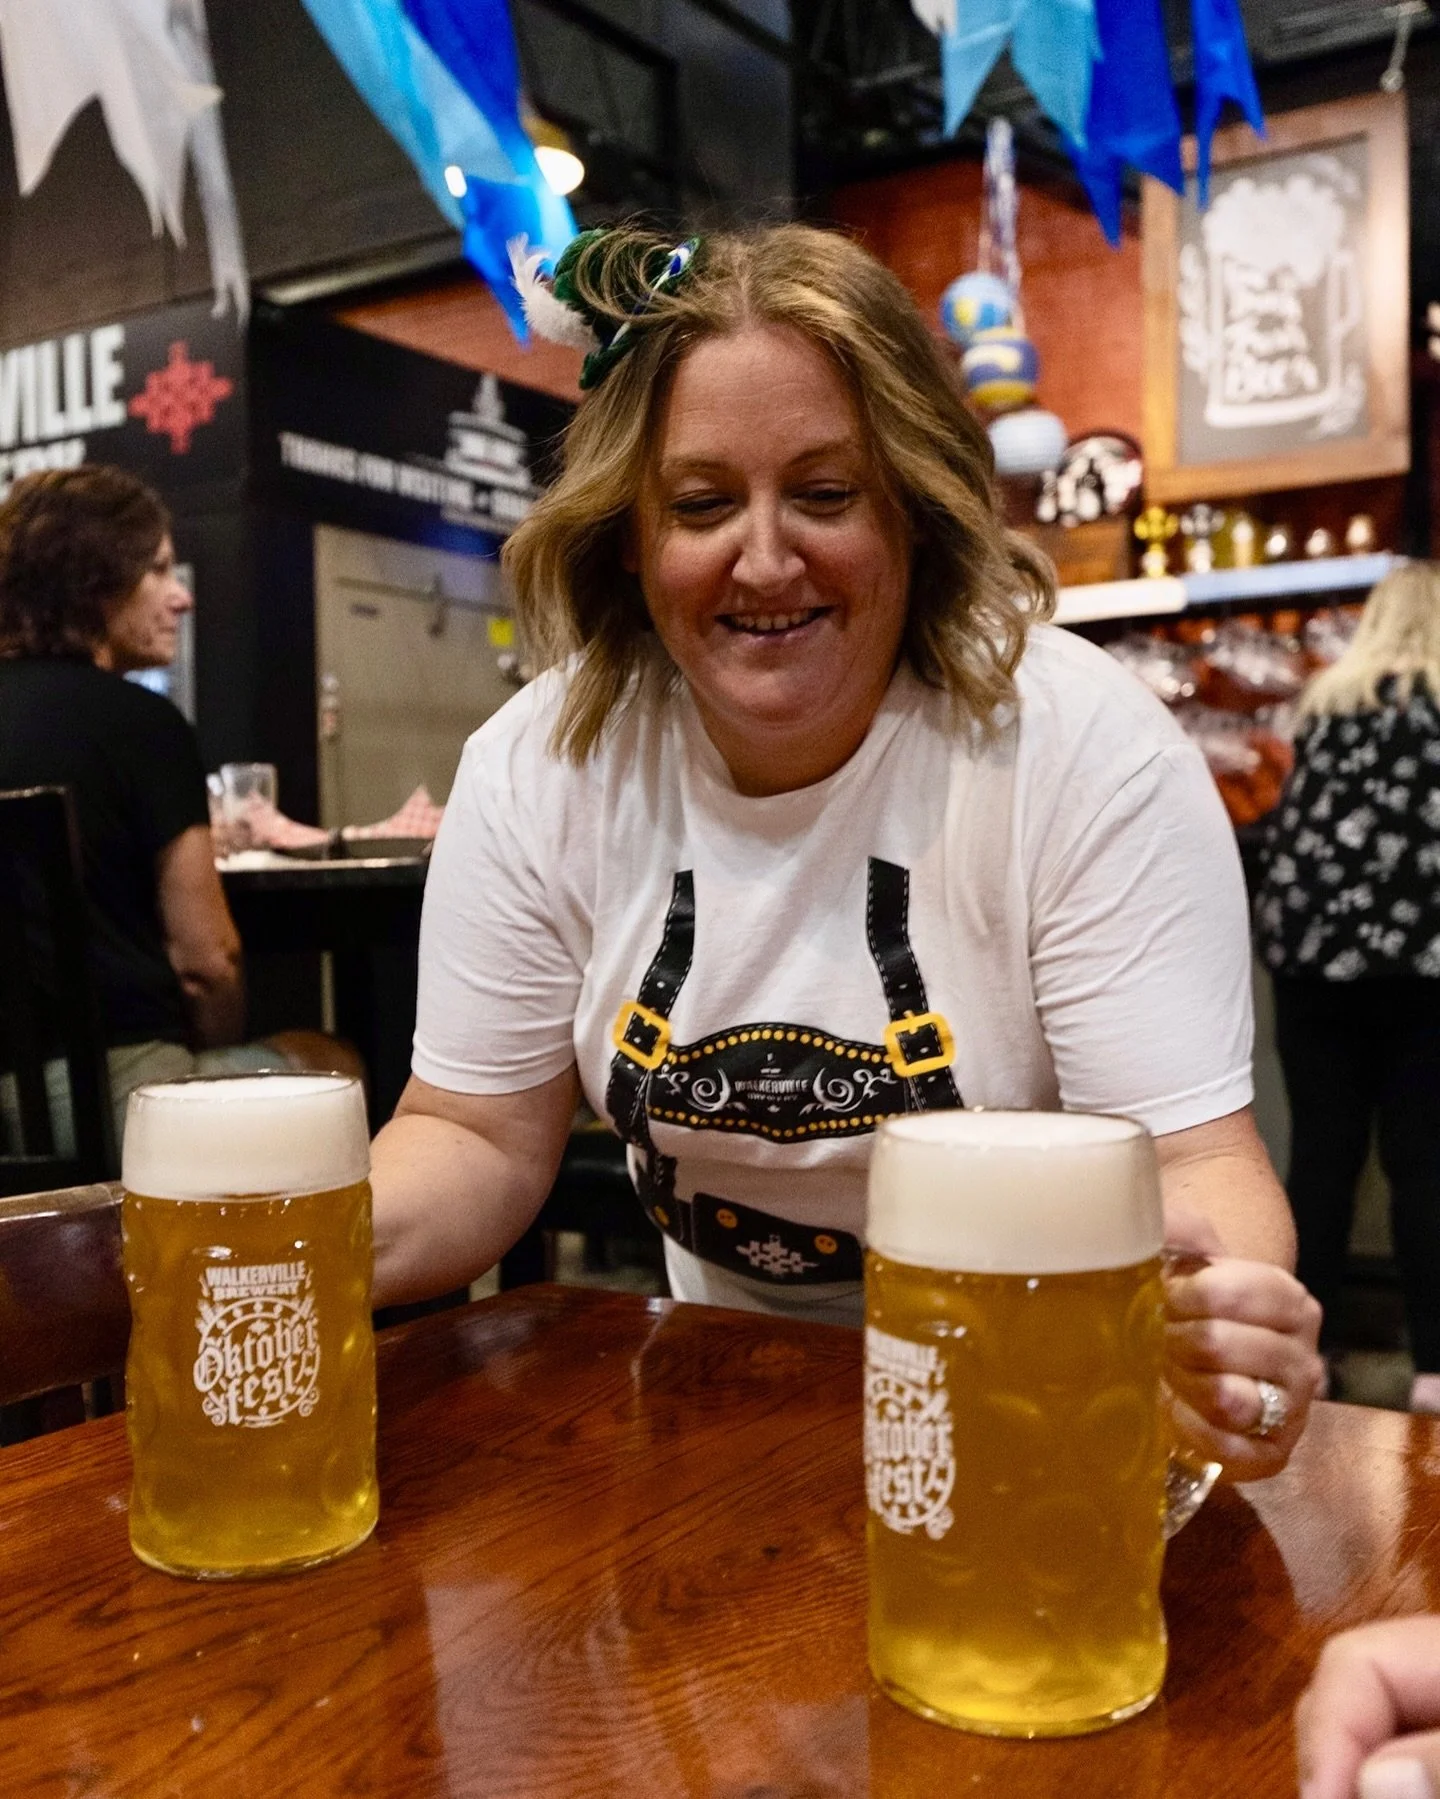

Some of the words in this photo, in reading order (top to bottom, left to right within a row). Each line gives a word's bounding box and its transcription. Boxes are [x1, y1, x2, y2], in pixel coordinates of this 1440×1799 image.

[734, 1079, 809, 1094] WALKERVILLE
[205, 1259, 307, 1289] WALKERVILLE
[212, 1281, 299, 1302] BREWERY
[193, 1317, 319, 1393] Oktober
[224, 1355, 298, 1426] fest
